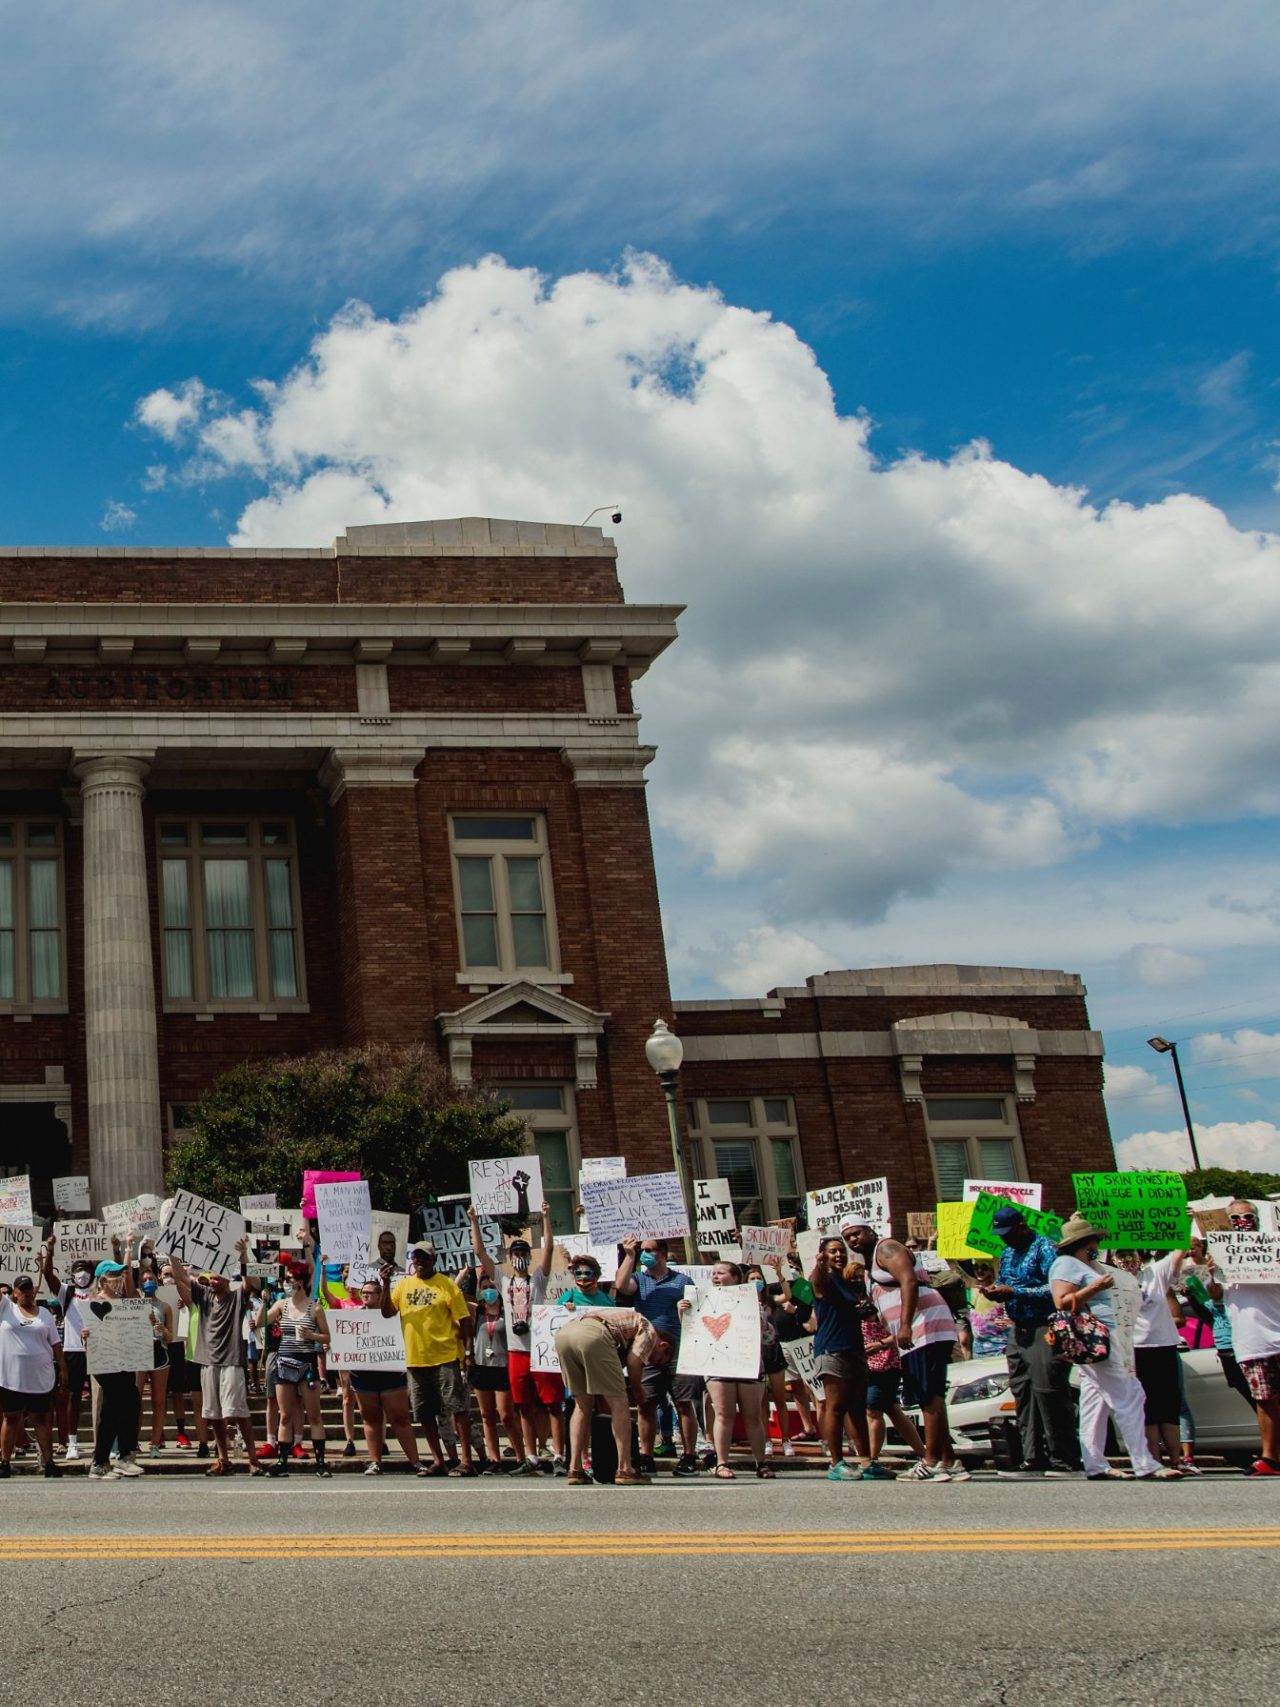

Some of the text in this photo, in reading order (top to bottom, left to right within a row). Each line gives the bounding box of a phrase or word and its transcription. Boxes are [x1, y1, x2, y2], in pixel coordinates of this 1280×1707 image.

[40, 677, 297, 700] AUDITORIUM
[470, 1159, 512, 1179] REST
[1076, 1174, 1182, 1187] MY SKIN GIVES ME
[697, 1182, 710, 1199] I
[815, 1180, 883, 1206] BLACK WOMEN
[1078, 1187, 1182, 1200] PRIVILEGE I DIDN'T
[476, 1192, 511, 1204] WHEN
[598, 1190, 649, 1208] BLACK
[1080, 1198, 1110, 1208] EARN
[174, 1193, 233, 1228] BLACK
[475, 1203, 513, 1214] PEACE
[833, 1198, 873, 1214] DESERVE
[1081, 1206, 1181, 1221] YOUR SKIN GIVES
[61, 1222, 108, 1236] I CAN'T
[1118, 1221, 1176, 1232] HATE YOU
[746, 1229, 769, 1244] SKIN
[1131, 1231, 1185, 1242] DESERVE
[1209, 1233, 1232, 1245] SAY
[61, 1237, 108, 1253] BREATHE
[1225, 1245, 1272, 1255] GEORGE
[1225, 1255, 1273, 1265] FLOYD
[336, 1319, 371, 1336] RESPECT
[356, 1335, 397, 1350] EXISTENCE
[331, 1352, 340, 1363] OR
[344, 1352, 367, 1363] EXPECT
